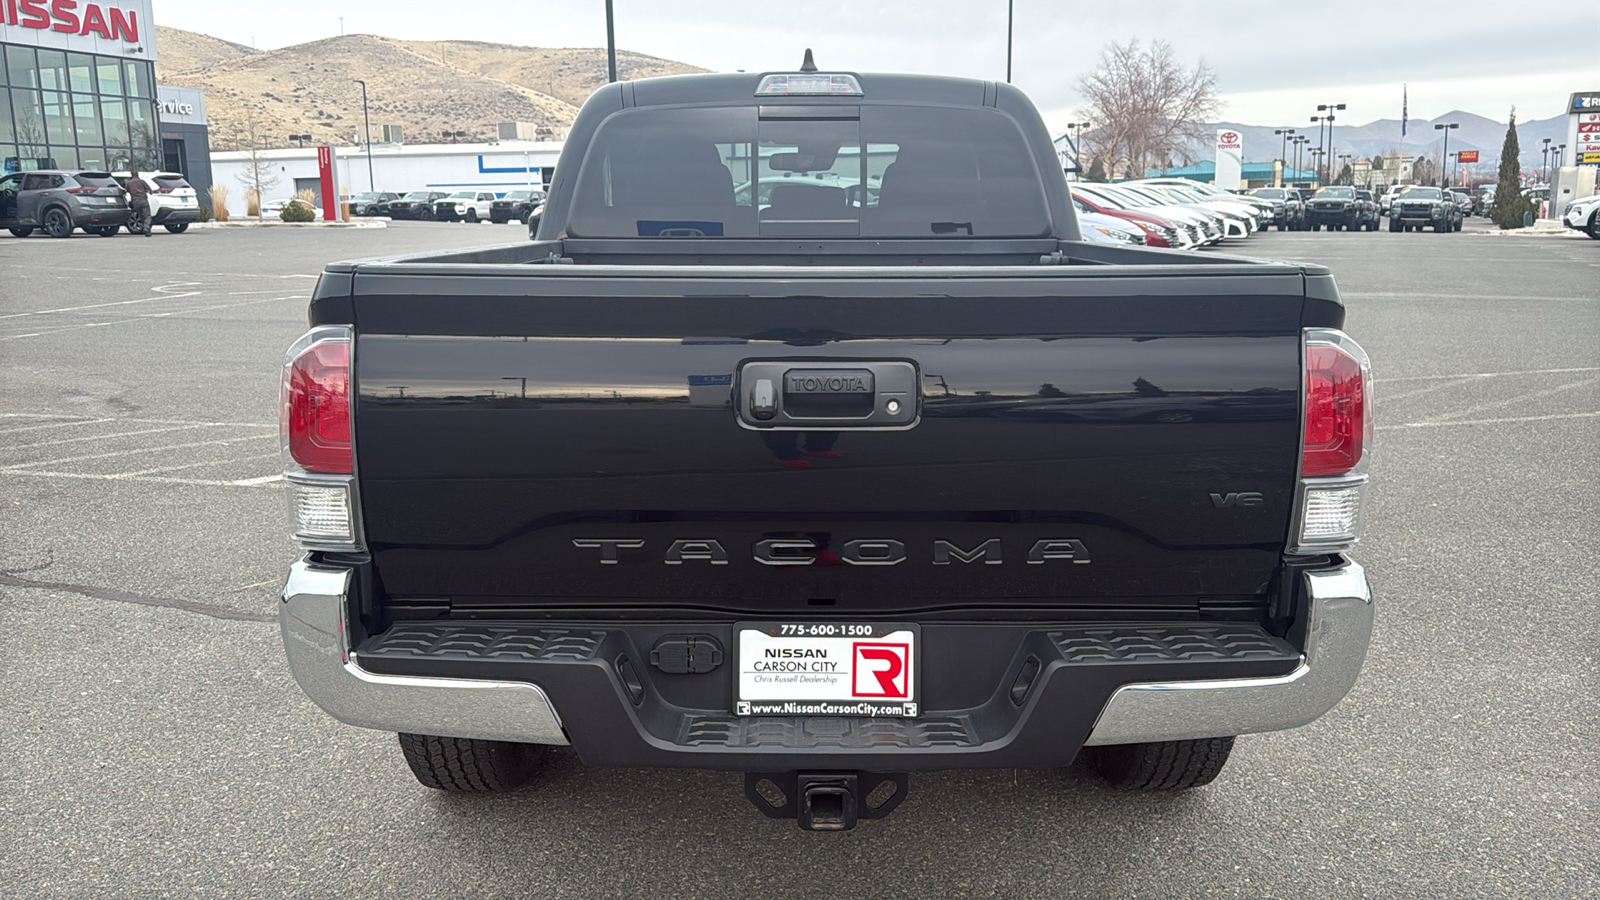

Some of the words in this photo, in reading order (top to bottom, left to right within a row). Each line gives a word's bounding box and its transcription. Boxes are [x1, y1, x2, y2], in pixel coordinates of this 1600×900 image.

[0, 0, 139, 42] ISSAN
[792, 376, 867, 391] TOYOTA
[1209, 492, 1263, 508] V6
[572, 538, 1091, 566] TACOMA
[781, 624, 873, 636] 775-600-1500
[765, 649, 827, 659] NISSAN
[753, 661, 807, 672] CARSON
[811, 662, 838, 673] CITY
[753, 675, 772, 684] Chris
[774, 675, 798, 684] Russell
[799, 675, 838, 686] Dealership
[752, 702, 902, 717] www.NissanCarsonCity.com
